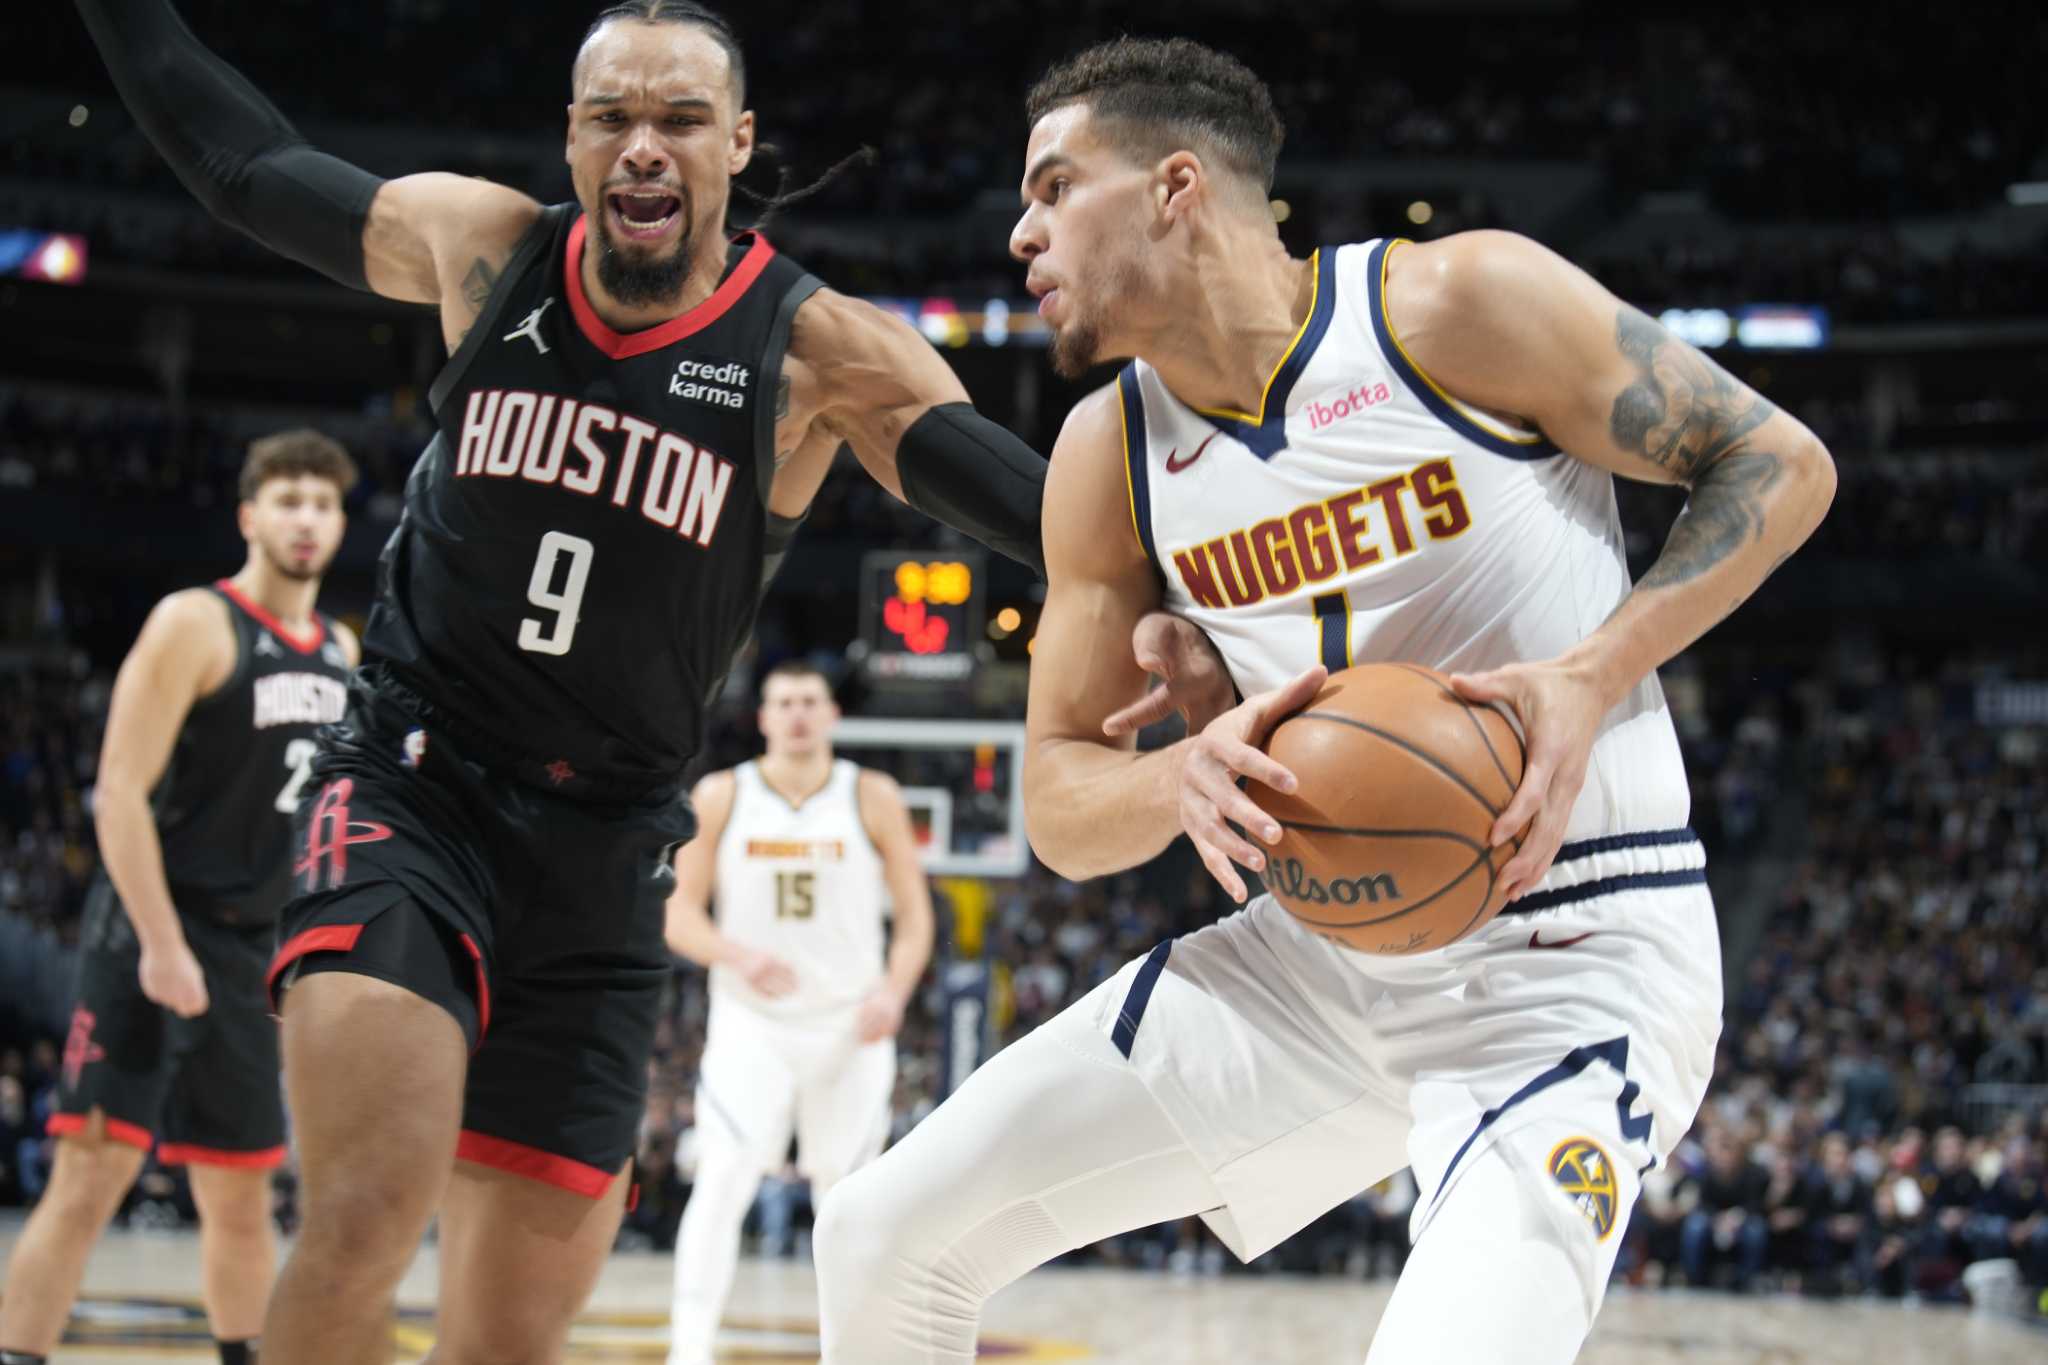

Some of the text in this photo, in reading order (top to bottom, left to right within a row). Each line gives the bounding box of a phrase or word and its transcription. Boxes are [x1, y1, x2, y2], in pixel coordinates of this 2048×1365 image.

[668, 373, 744, 409] karma
[678, 359, 750, 388] credit
[1306, 380, 1391, 430] ibotta
[455, 389, 735, 548] HOUSTON
[1172, 456, 1472, 609] NUGGETS
[517, 530, 595, 656] 9
[1312, 587, 1354, 675] 1
[774, 870, 815, 921] 15
[1264, 857, 1403, 905] ilson
